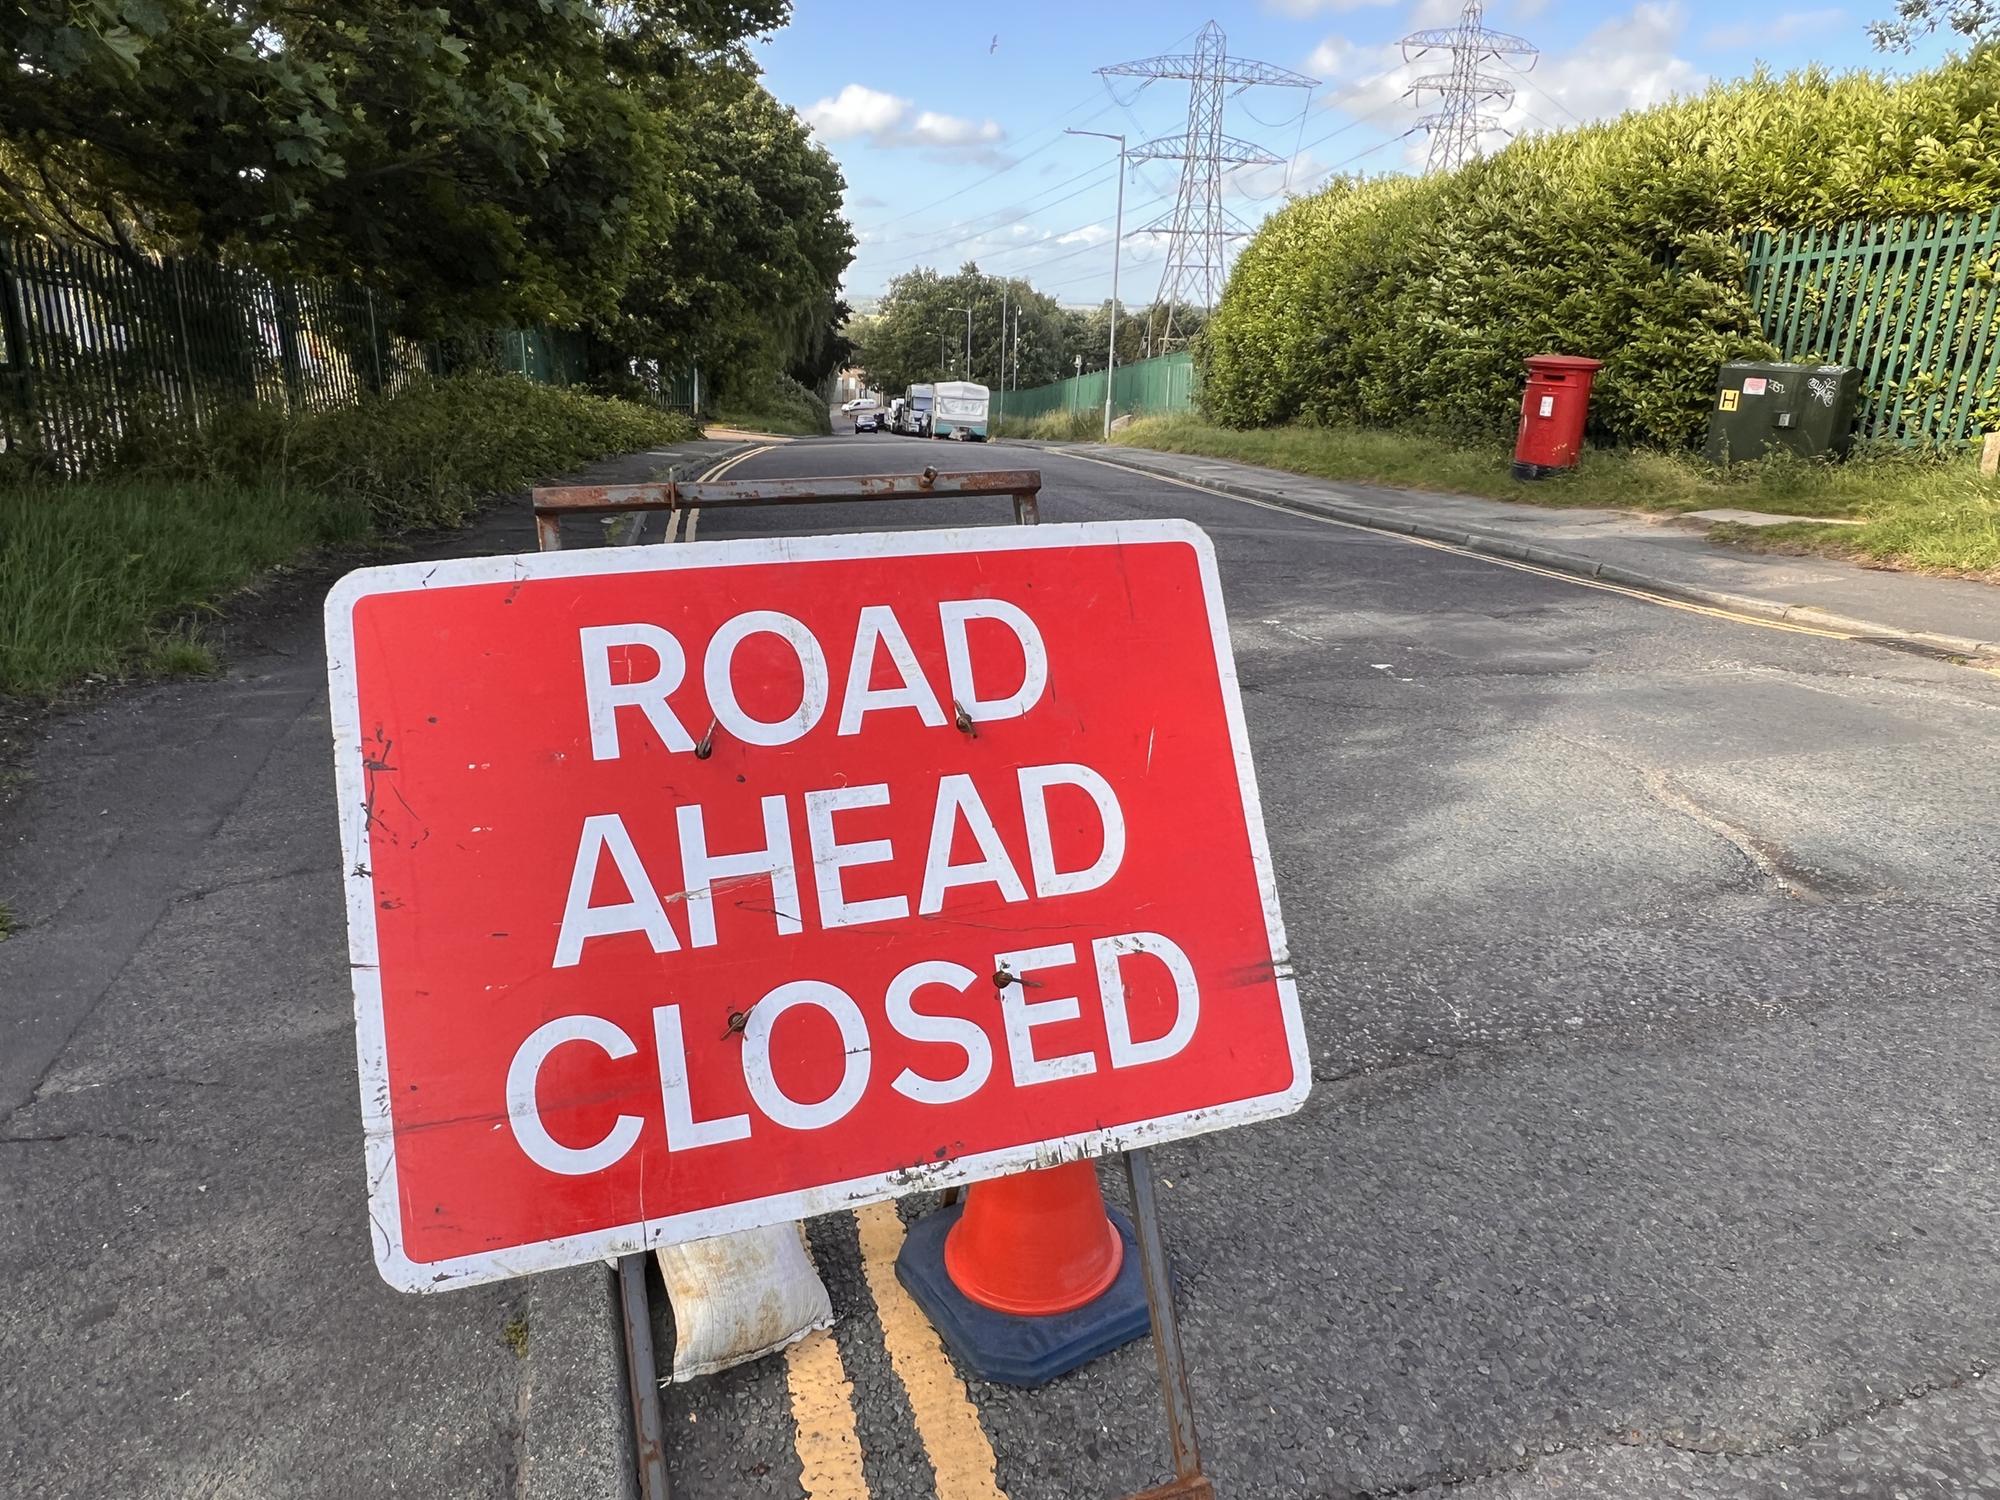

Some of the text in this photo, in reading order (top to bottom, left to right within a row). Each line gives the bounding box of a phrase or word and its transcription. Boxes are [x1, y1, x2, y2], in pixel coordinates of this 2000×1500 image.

[1722, 392, 1736, 409] H
[579, 598, 1049, 761] ROAD
[551, 763, 1126, 969] AHEAD
[505, 931, 1201, 1176] CLOSED
